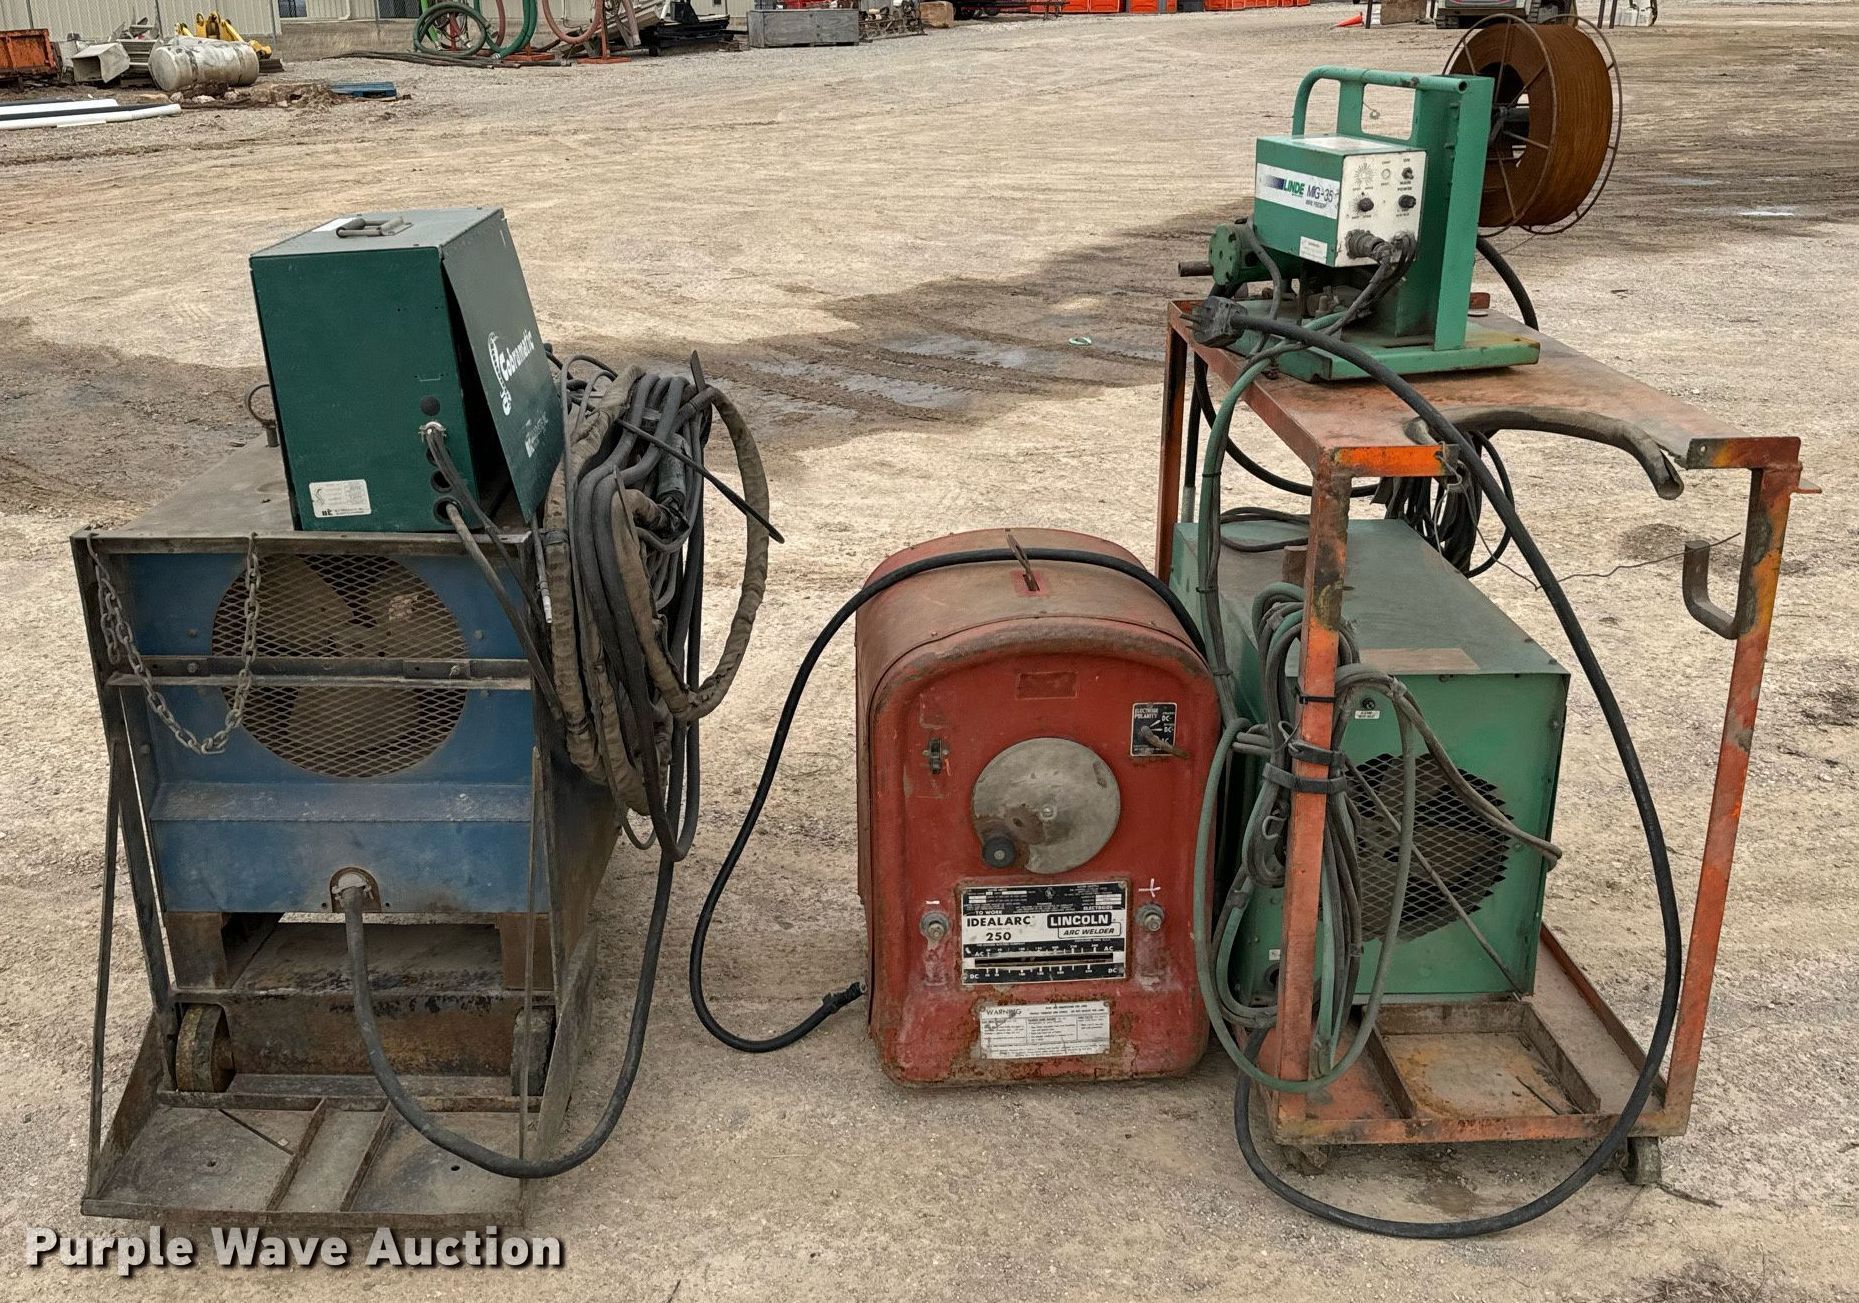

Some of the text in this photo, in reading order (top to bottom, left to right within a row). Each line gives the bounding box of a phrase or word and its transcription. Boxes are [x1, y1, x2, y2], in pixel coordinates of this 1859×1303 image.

[1283, 178, 1305, 195] LINDE
[967, 915, 1031, 927] IDEALARC
[1050, 914, 1109, 927] LINCOLN
[985, 931, 1012, 942] 250
[1082, 927, 1115, 935] WELDER
[986, 1008, 1022, 1016] WARNING
